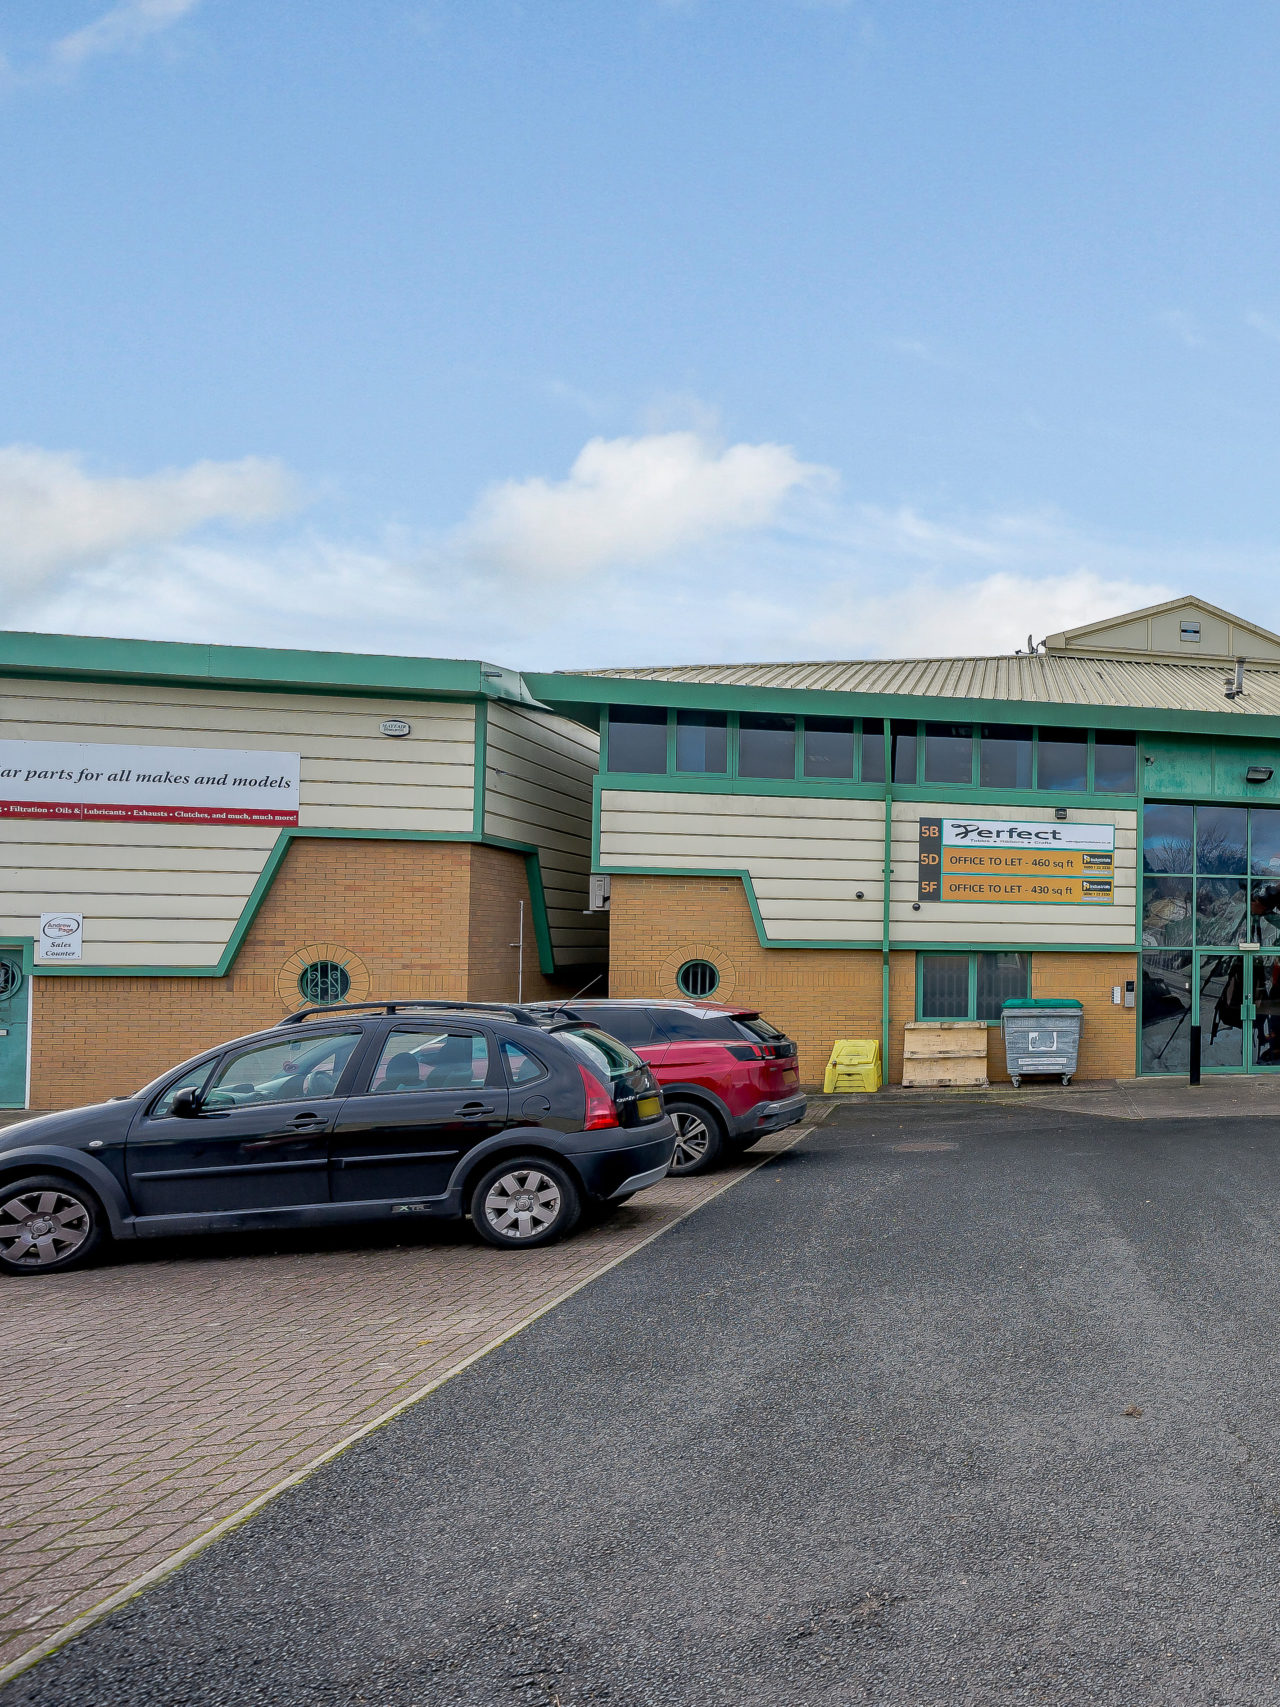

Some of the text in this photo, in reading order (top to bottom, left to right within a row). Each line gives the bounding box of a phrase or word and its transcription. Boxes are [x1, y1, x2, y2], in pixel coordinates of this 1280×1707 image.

[0, 766, 291, 788] ar parts for all makes and models
[9, 805, 48, 813] Filtration
[133, 809, 168, 817] Exhausts
[175, 811, 210, 819] Clutches,
[921, 825, 939, 837] 5B
[950, 823, 1062, 840] Perfect
[920, 853, 939, 865] 5D
[950, 856, 985, 865] OFFICE
[988, 857, 1002, 866] TO
[1005, 857, 1023, 866] LET
[1031, 858, 1050, 867] 460
[1052, 861, 1064, 869] sq
[1066, 859, 1074, 868] ft
[921, 881, 938, 893] 5F
[949, 883, 985, 892] OFFICE
[988, 884, 1001, 893] TO
[1004, 885, 1022, 893] LET
[1031, 885, 1049, 894] 430
[1051, 888, 1063, 896] sq
[1065, 886, 1072, 895] ft
